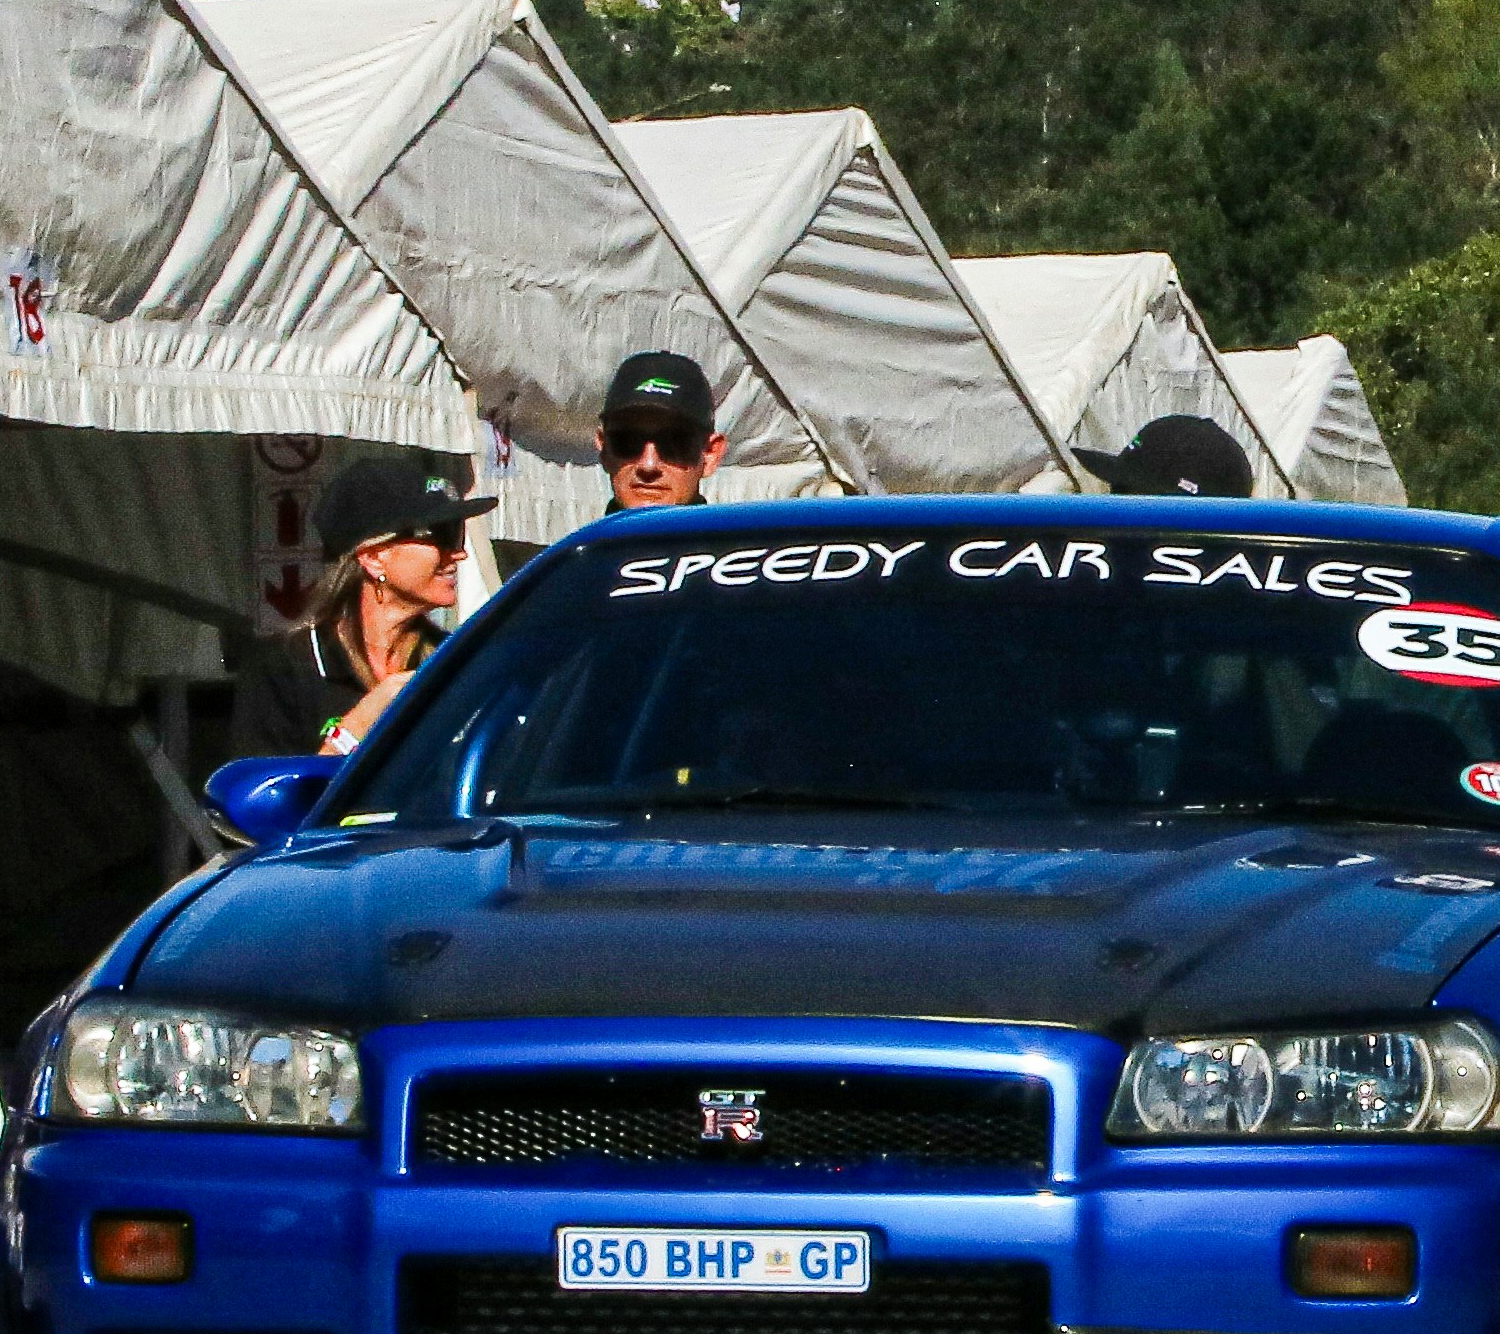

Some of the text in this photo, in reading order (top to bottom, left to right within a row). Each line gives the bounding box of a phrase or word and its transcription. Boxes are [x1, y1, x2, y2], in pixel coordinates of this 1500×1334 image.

[609, 540, 1413, 605] SPEEDY CAR SALES
[571, 1238, 858, 1280] 850 BHP GP
